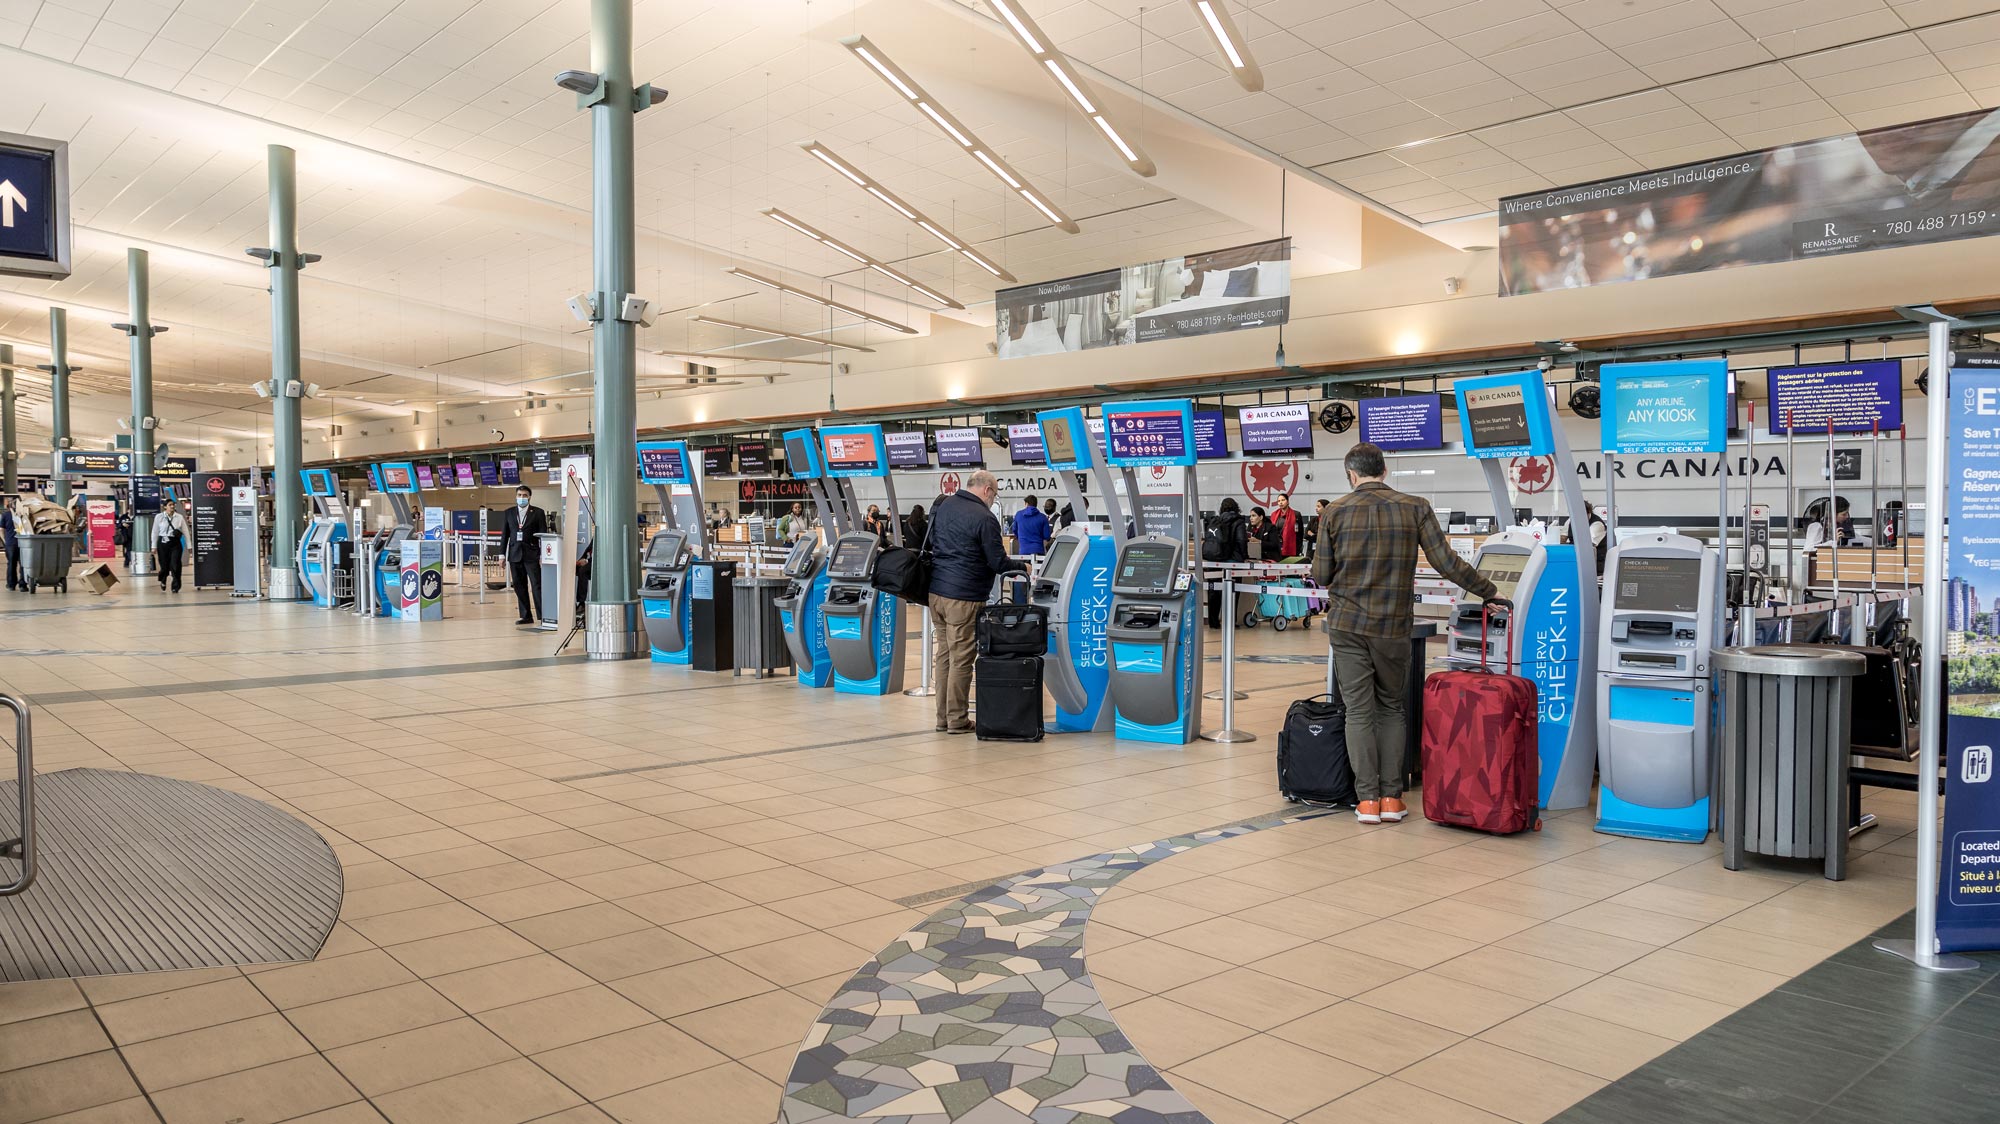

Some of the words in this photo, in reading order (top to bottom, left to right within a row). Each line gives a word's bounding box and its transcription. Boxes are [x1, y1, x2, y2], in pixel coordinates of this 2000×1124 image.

[1505, 199, 1543, 214] Where
[1546, 185, 1625, 207] Convenience
[1629, 176, 1669, 194] Meets
[1673, 162, 1755, 185] Indulgence.
[1886, 220, 1912, 236] 780
[1916, 216, 1944, 232] 488
[1950, 210, 1986, 227] 7159
[1824, 223, 1839, 238] R
[1802, 236, 1860, 249] RENAISSANCE
[1038, 285, 1053, 295] Now
[1150, 319, 1157, 329] R
[1176, 319, 1189, 329] 780
[1190, 318, 1203, 328] 488
[1204, 315, 1222, 326] 7159
[1227, 309, 1284, 322] RenHotels.com
[1823, 370, 1852, 378] protection
[1478, 394, 1491, 402] AIR
[1491, 390, 1521, 401] CANADA
[1636, 398, 1653, 407] ANY
[1654, 397, 1686, 407] AIRLINE,
[1963, 387, 1975, 415] YEG
[1977, 387, 2000, 415] E
[1270, 409, 1303, 418] CANADA
[1627, 409, 1654, 423] ANY
[1657, 408, 1696, 422] KIOSK
[1963, 427, 1991, 438] Save
[1667, 445, 1704, 453] CHECK-IN
[1576, 460, 1626, 479] AIR
[1636, 456, 1787, 479] CANADA
[996, 477, 1058, 491] CANADA
[1974, 559, 1990, 567] YEG
[1092, 567, 1108, 667] CHECK-IN
[1548, 587, 1568, 722] CHECK-IN
[1961, 840, 2000, 851] Located
[1960, 870, 1986, 881] Situé
[1987, 870, 1994, 880] à
[1960, 883, 1993, 894] niveau
